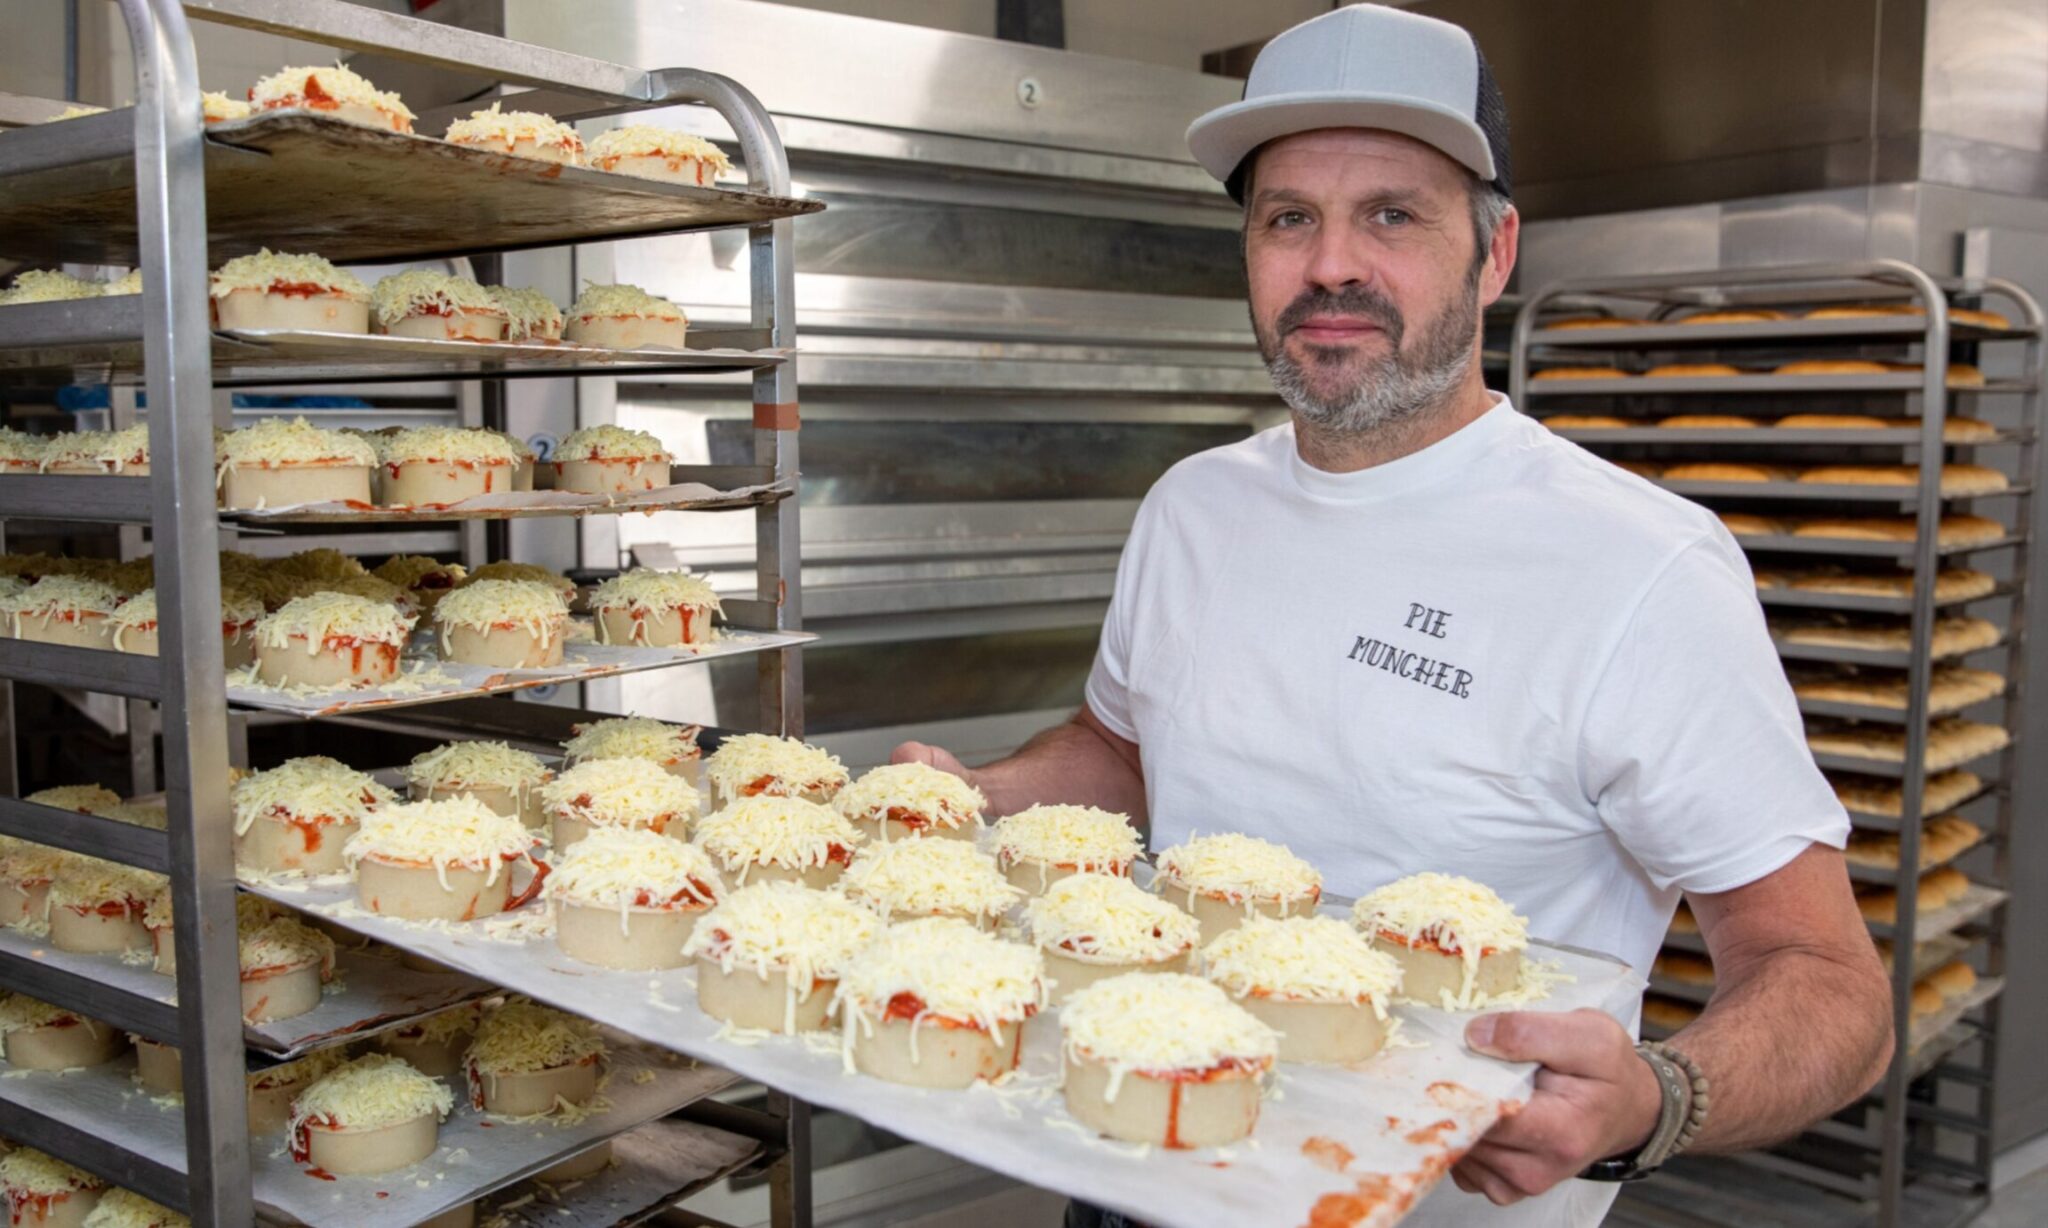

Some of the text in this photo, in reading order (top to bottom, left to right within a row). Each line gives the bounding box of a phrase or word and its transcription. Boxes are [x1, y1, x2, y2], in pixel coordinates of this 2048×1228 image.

[1025, 83, 1036, 104] 2
[1403, 602, 1453, 638] PIE
[1347, 635, 1473, 699] MUNCHER
